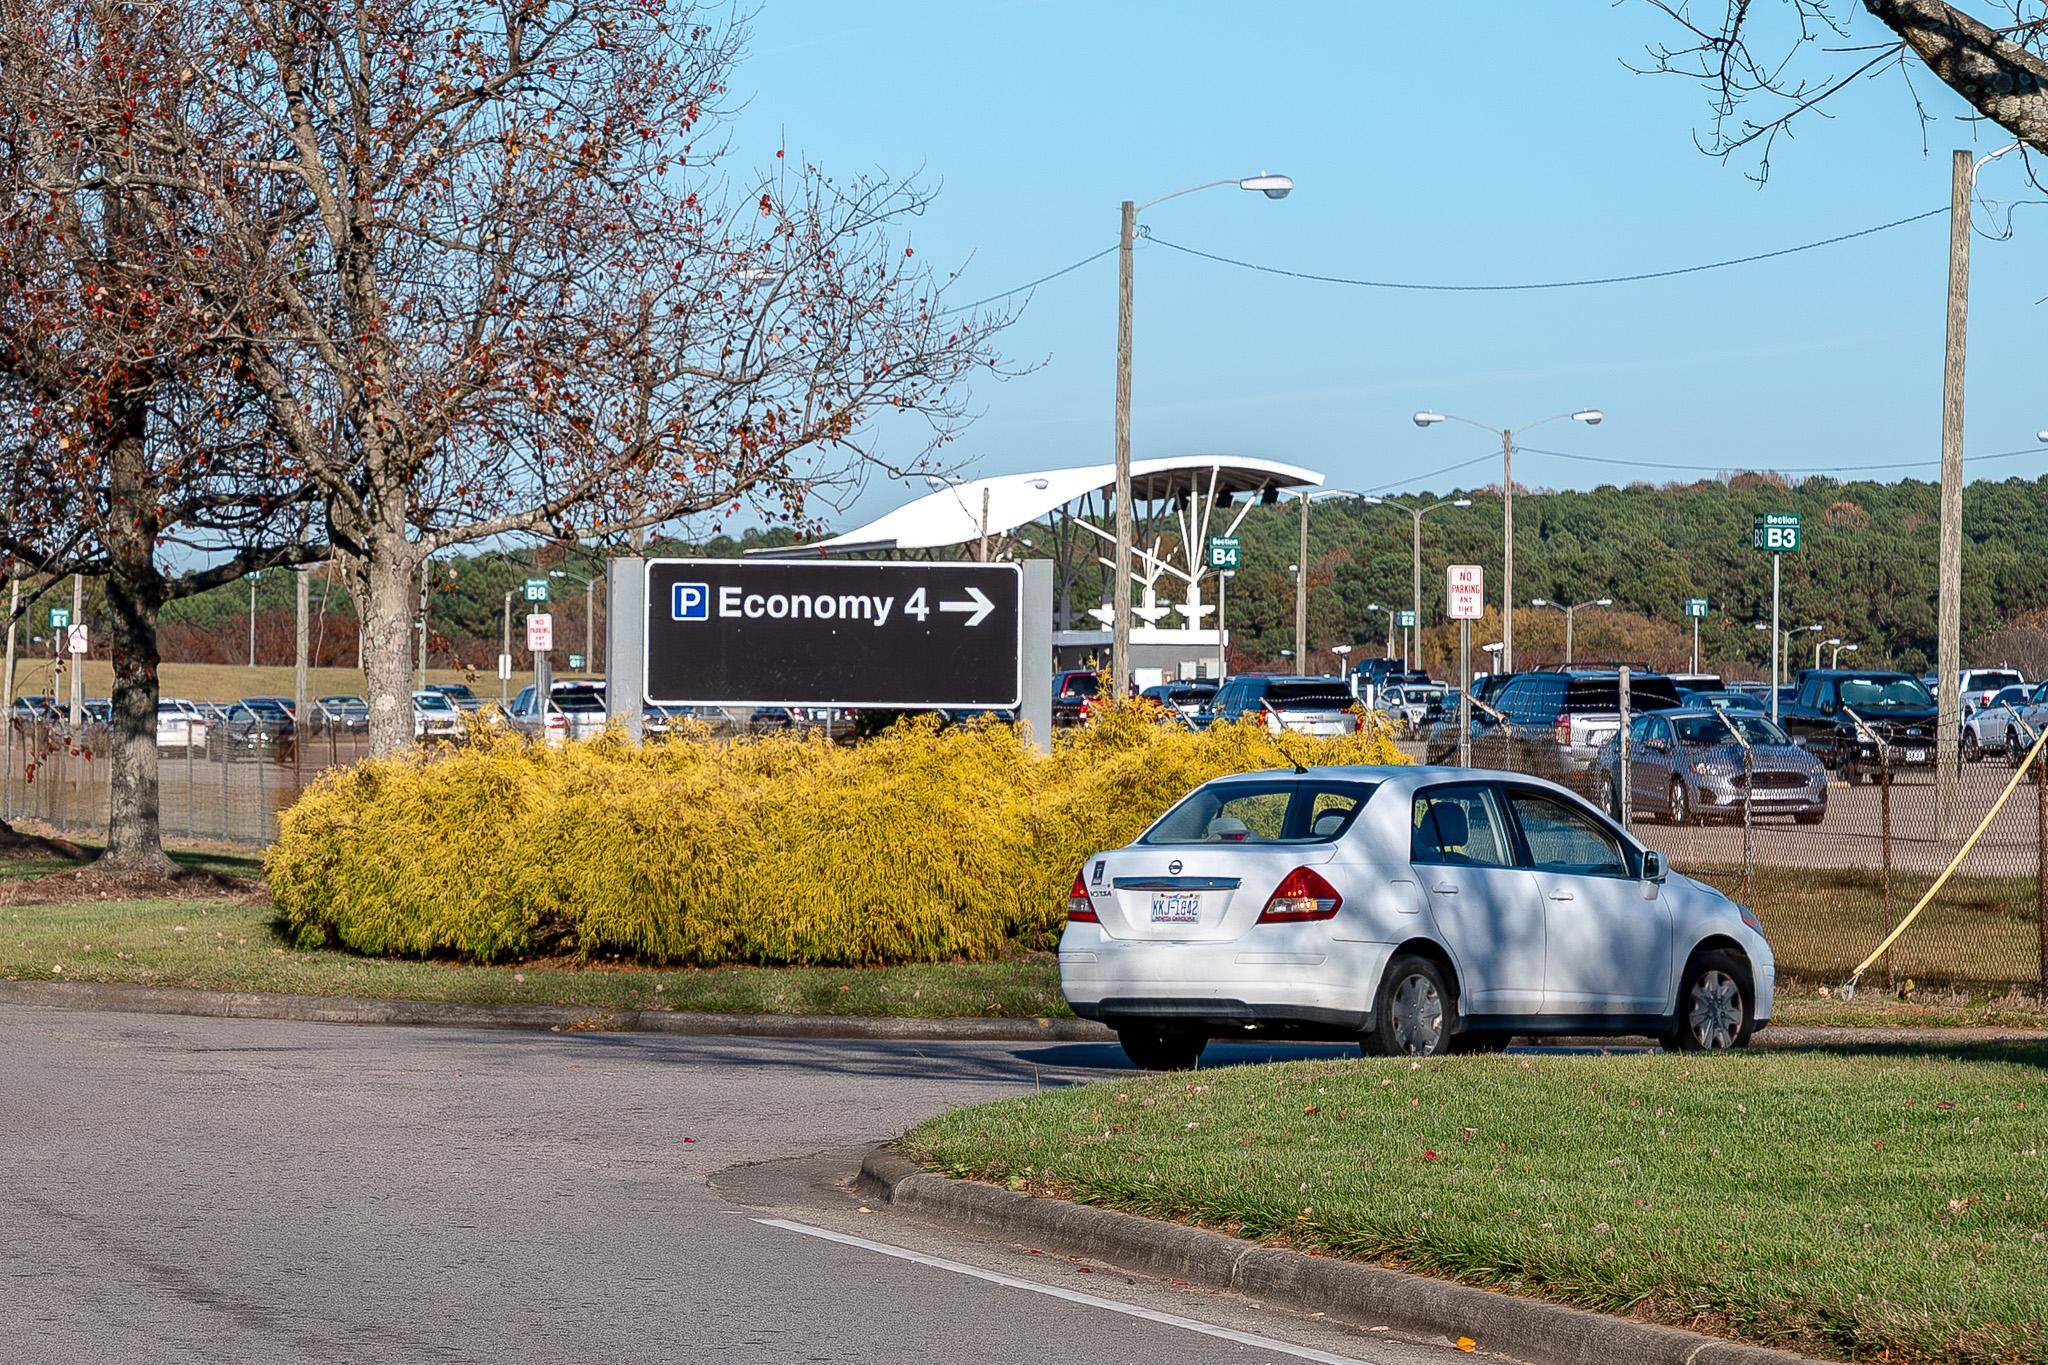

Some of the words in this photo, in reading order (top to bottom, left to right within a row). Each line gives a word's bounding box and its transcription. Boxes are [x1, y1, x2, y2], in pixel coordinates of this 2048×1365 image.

[1767, 514, 1798, 525] Section
[1212, 537, 1239, 546] Section
[1767, 527, 1796, 548] B3
[1212, 548, 1237, 566] B4
[1459, 571, 1473, 582] NO
[1450, 584, 1481, 594] PARKING
[1459, 596, 1473, 604] ANY
[680, 588, 702, 616] P
[718, 586, 895, 627] Economy
[903, 586, 930, 622] 4
[1152, 899, 1199, 916] KKJ-1842
